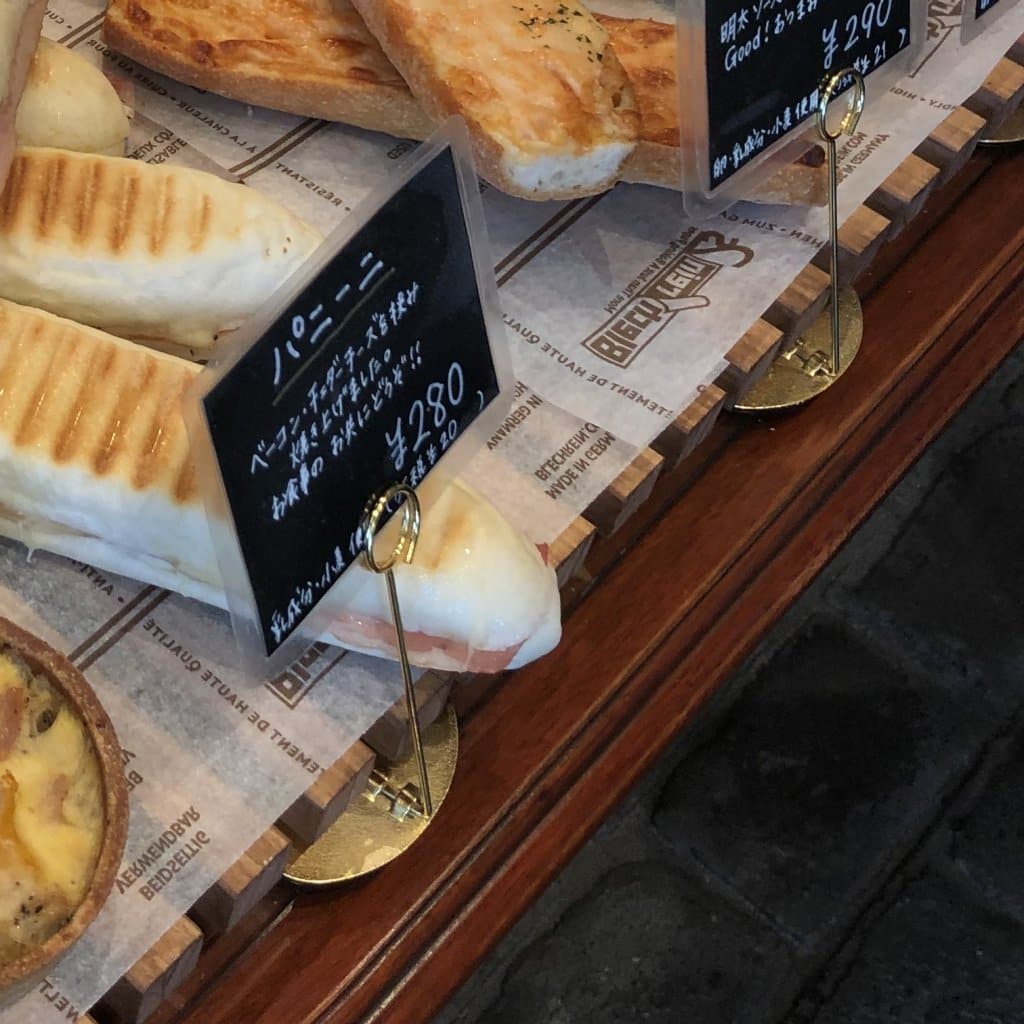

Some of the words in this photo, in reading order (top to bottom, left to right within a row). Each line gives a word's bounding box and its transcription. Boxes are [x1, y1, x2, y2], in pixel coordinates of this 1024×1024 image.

[272, 251, 384, 386] パニーニ
[383, 361, 465, 473] ¥280
